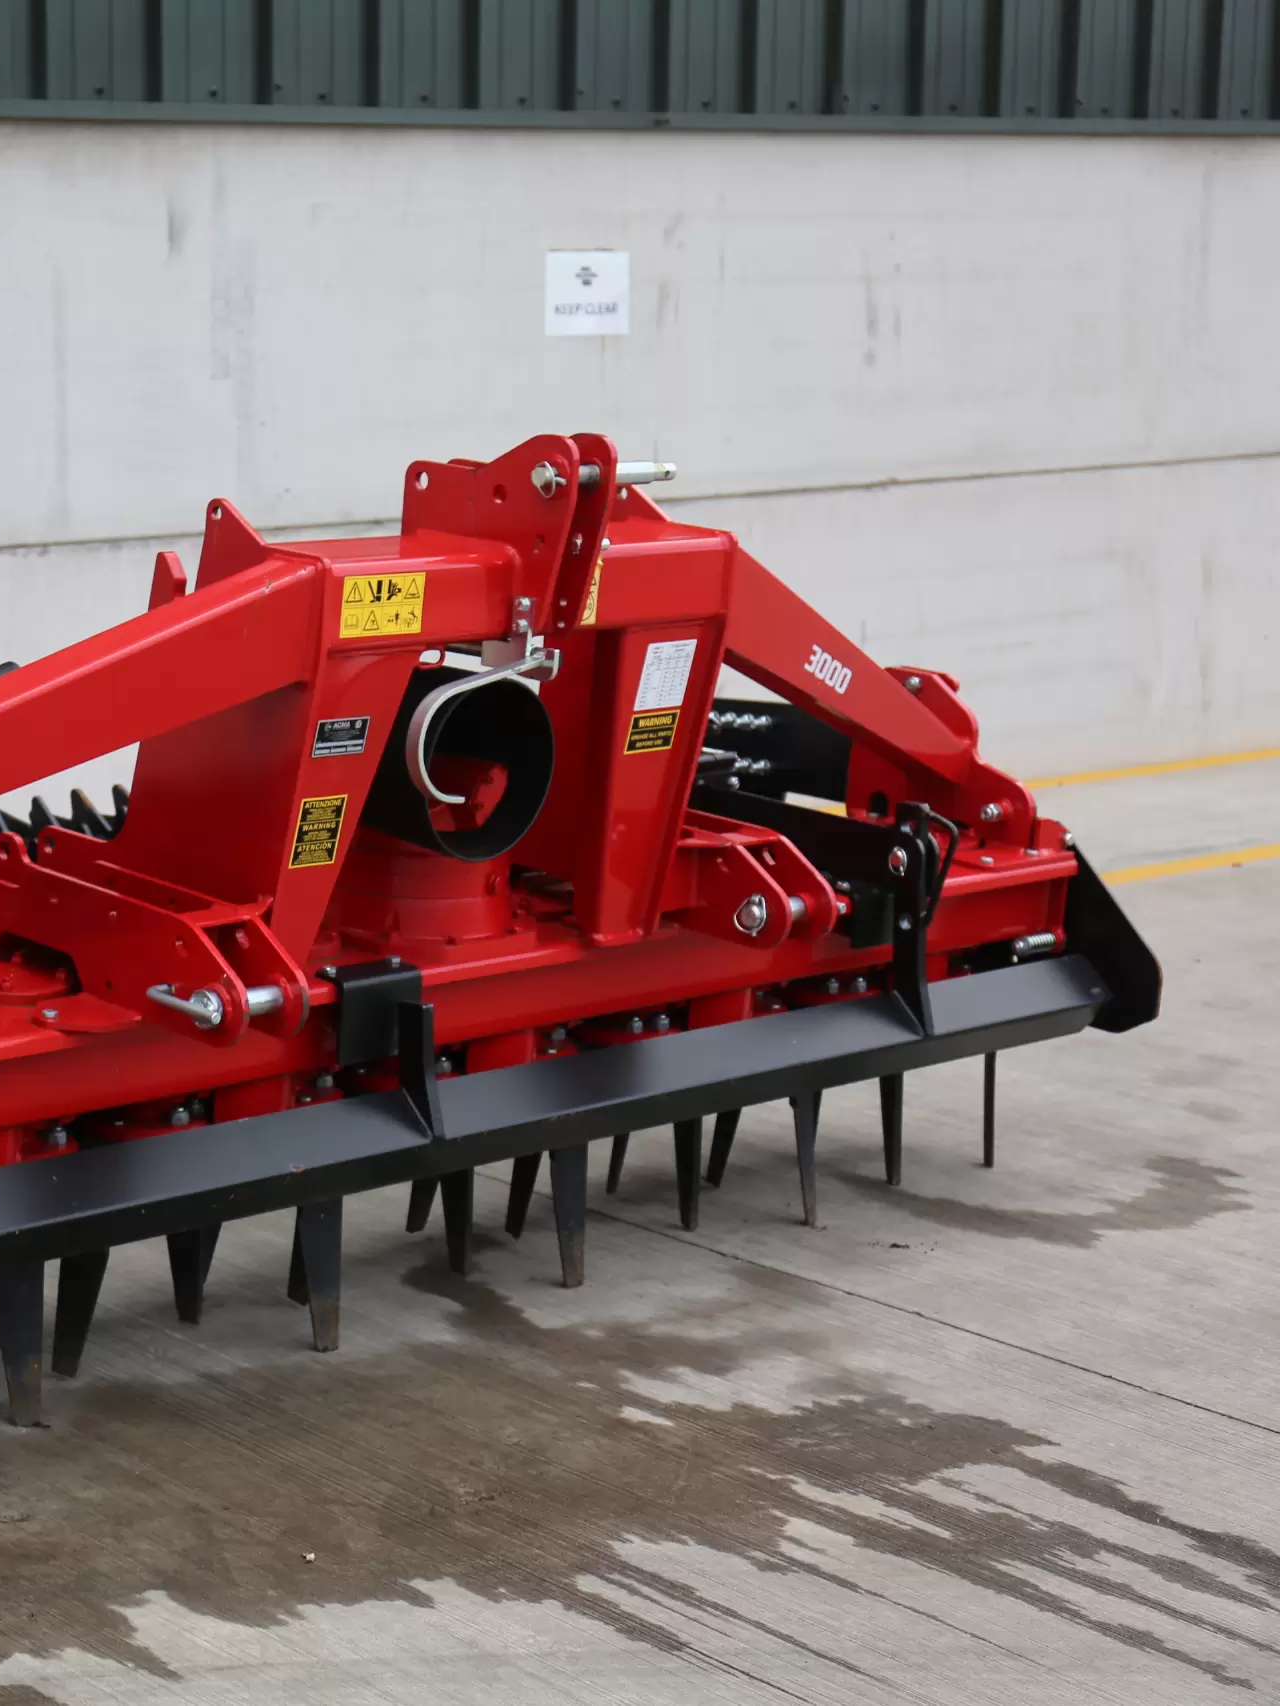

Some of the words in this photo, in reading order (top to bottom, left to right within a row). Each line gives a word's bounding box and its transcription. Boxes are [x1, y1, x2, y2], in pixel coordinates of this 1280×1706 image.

[804, 644, 853, 694] 3000
[639, 715, 673, 728] WARNING
[304, 799, 343, 809] ATTENZIONE
[302, 822, 337, 832] WARNING
